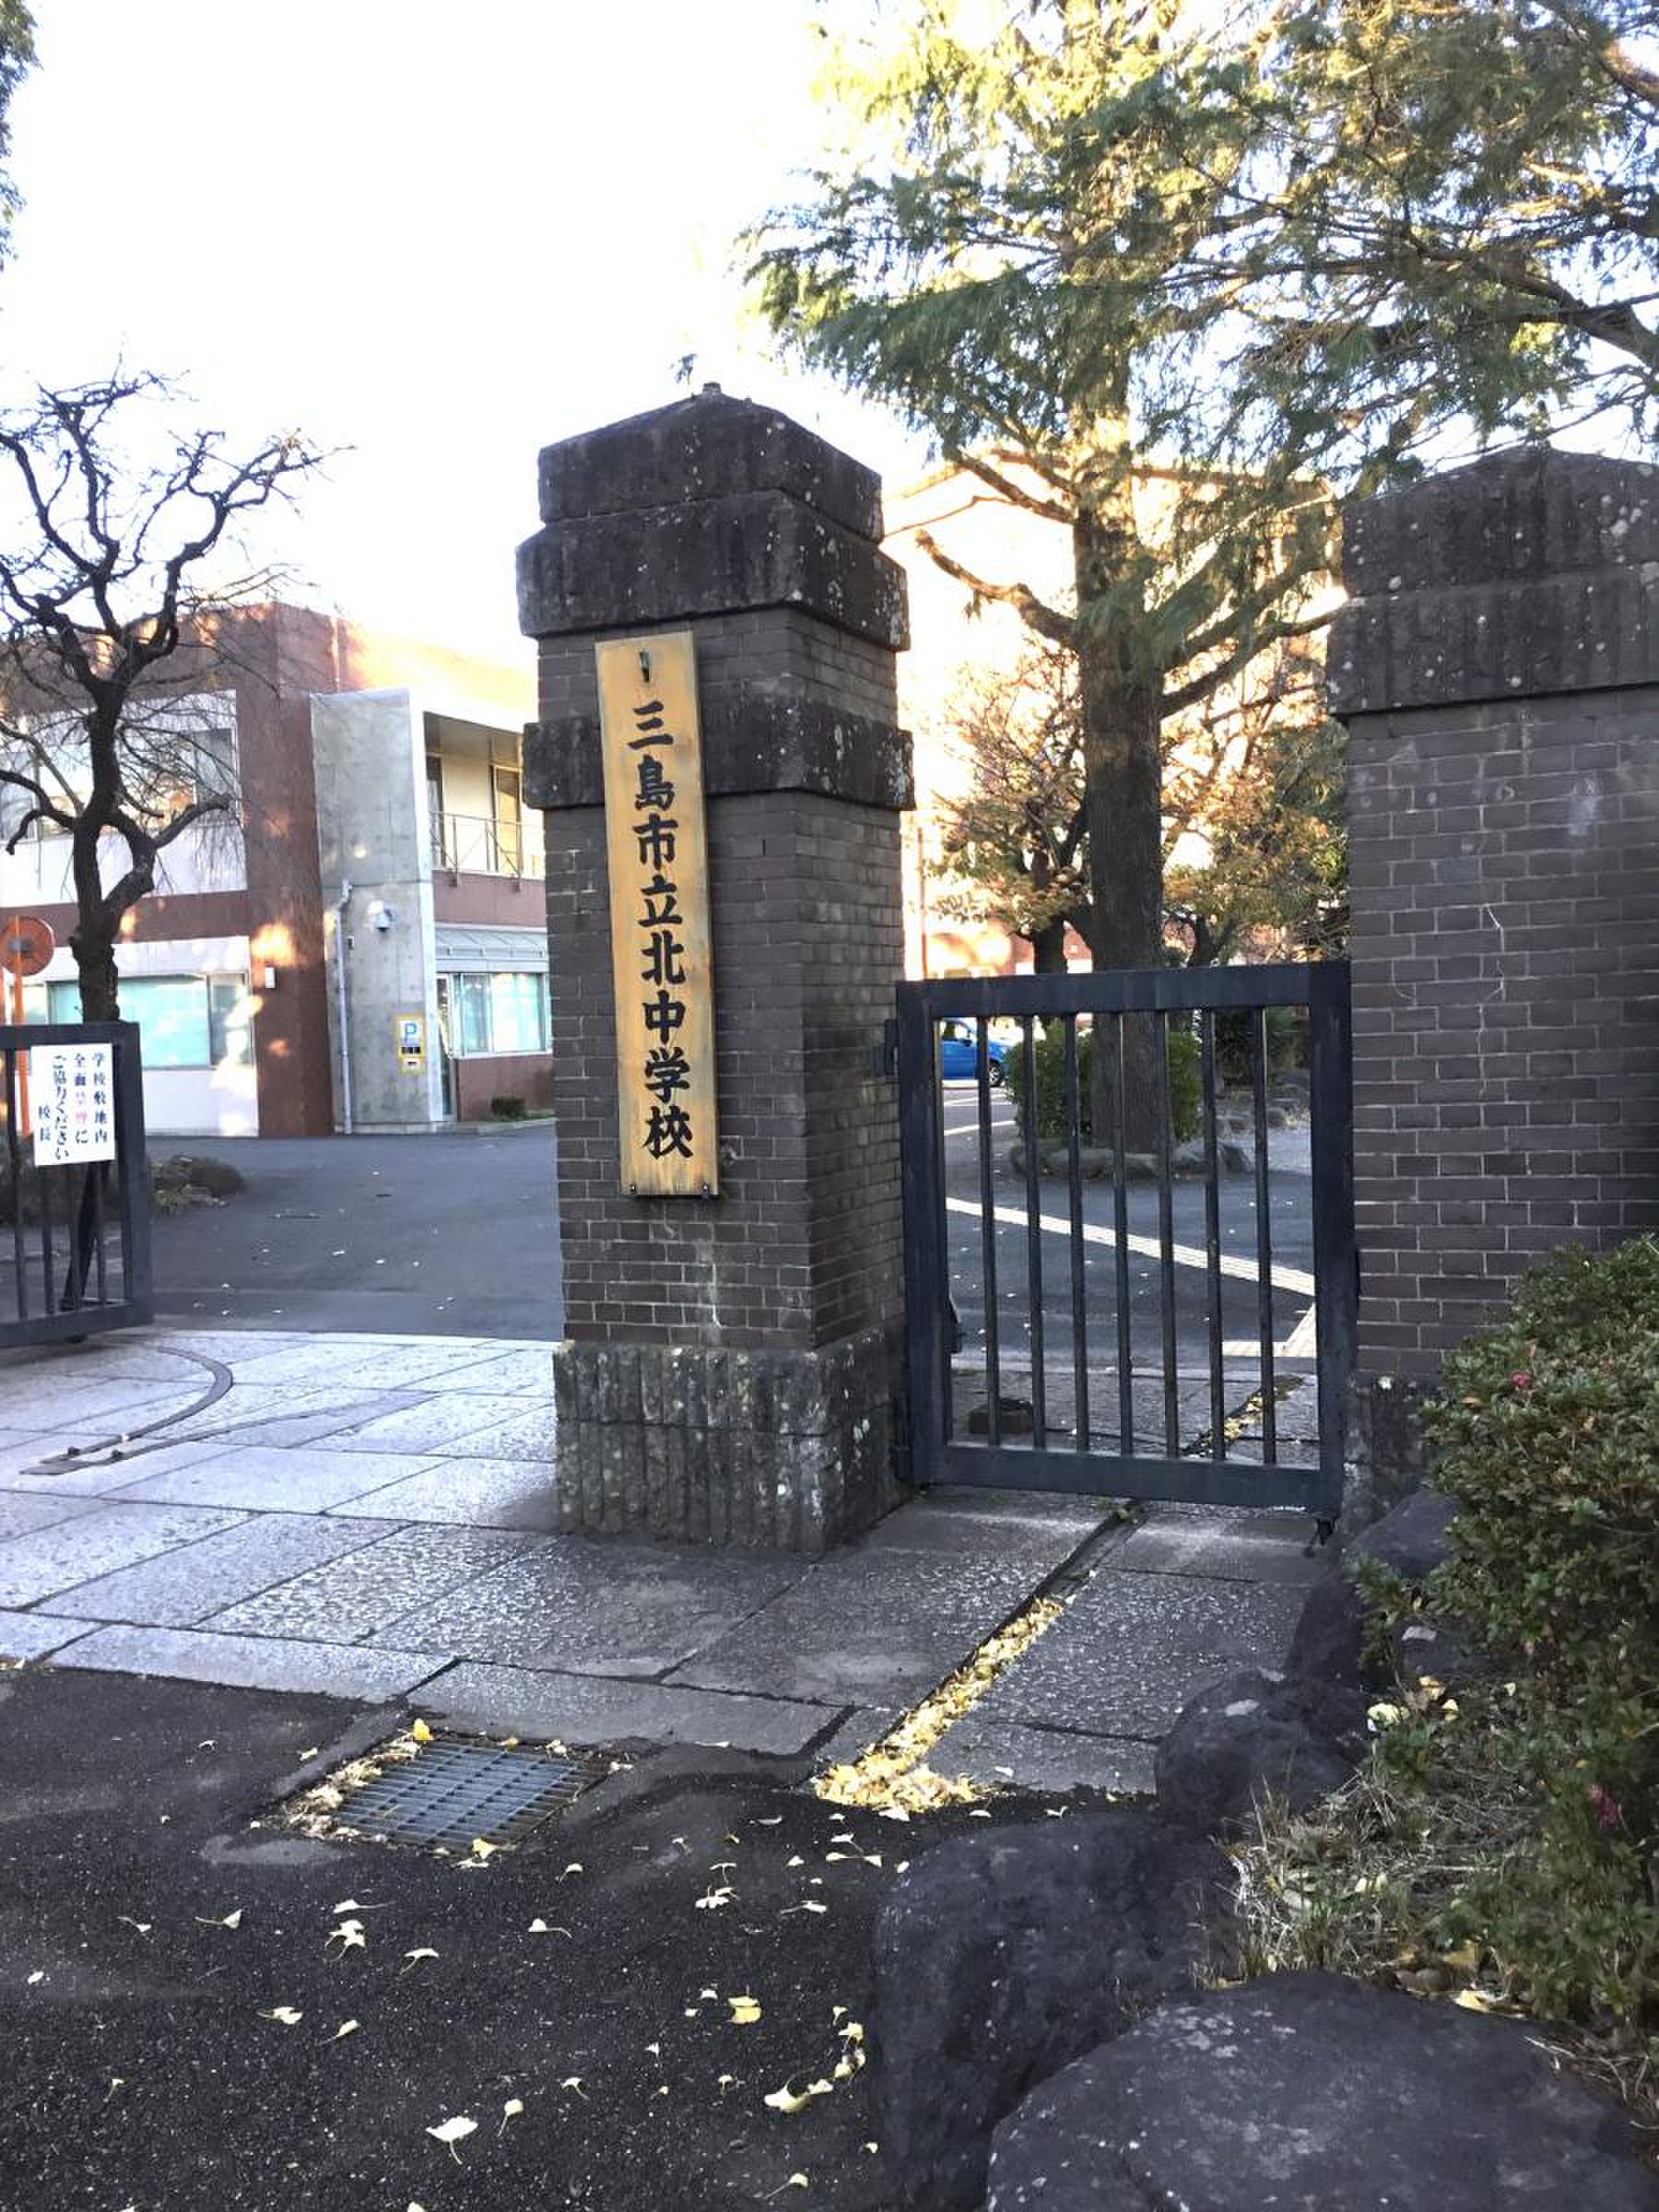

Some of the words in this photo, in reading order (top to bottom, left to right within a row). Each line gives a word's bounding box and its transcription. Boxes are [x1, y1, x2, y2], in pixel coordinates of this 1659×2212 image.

[404, 1022, 418, 1043] P
[627, 701, 694, 1159] 三島市立北中学校
